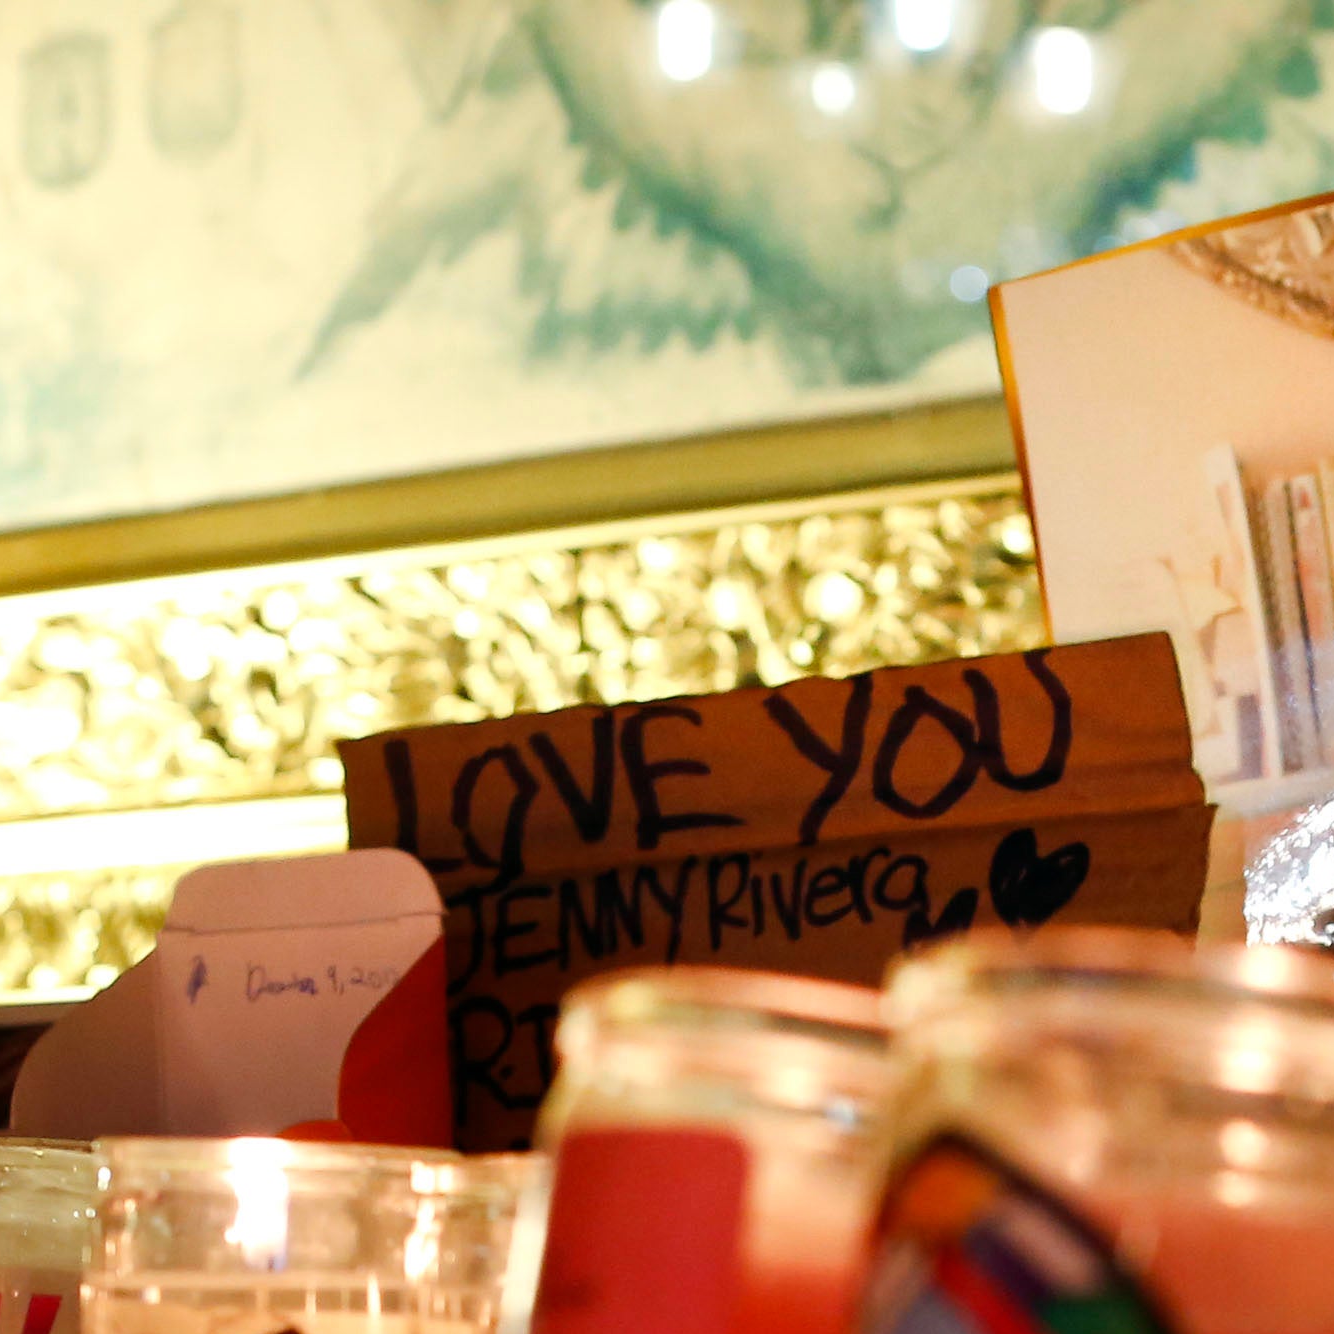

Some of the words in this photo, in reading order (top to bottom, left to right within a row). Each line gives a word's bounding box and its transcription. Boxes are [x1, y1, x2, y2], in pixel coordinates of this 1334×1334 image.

[382, 704, 745, 882] LOVE
[764, 648, 1073, 846] YOU
[447, 855, 699, 994] JENNY
